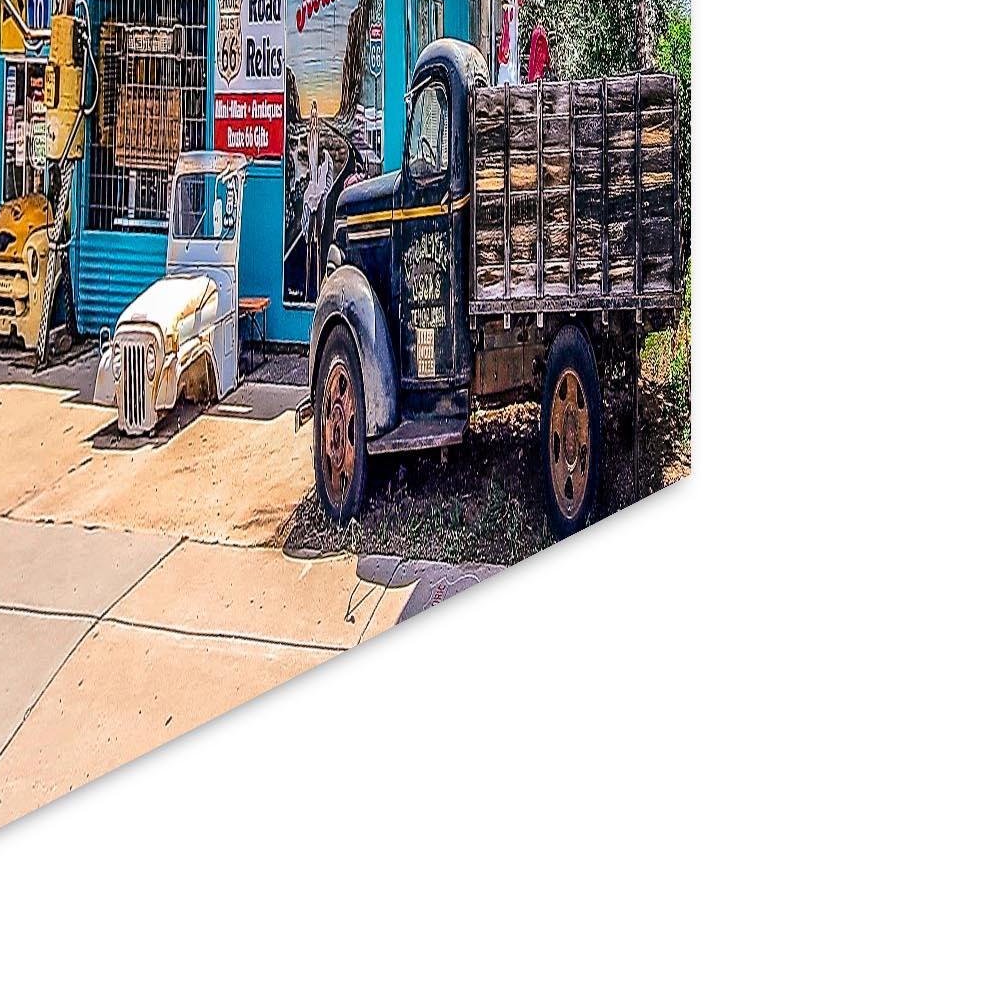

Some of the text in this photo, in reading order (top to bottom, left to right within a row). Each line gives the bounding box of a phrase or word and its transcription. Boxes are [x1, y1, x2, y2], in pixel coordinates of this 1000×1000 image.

[221, 36, 237, 71] 66
[246, 36, 282, 77] Relics
[251, 99, 283, 121] Antiques
[227, 126, 245, 147] Route
[245, 126, 254, 147] 66
